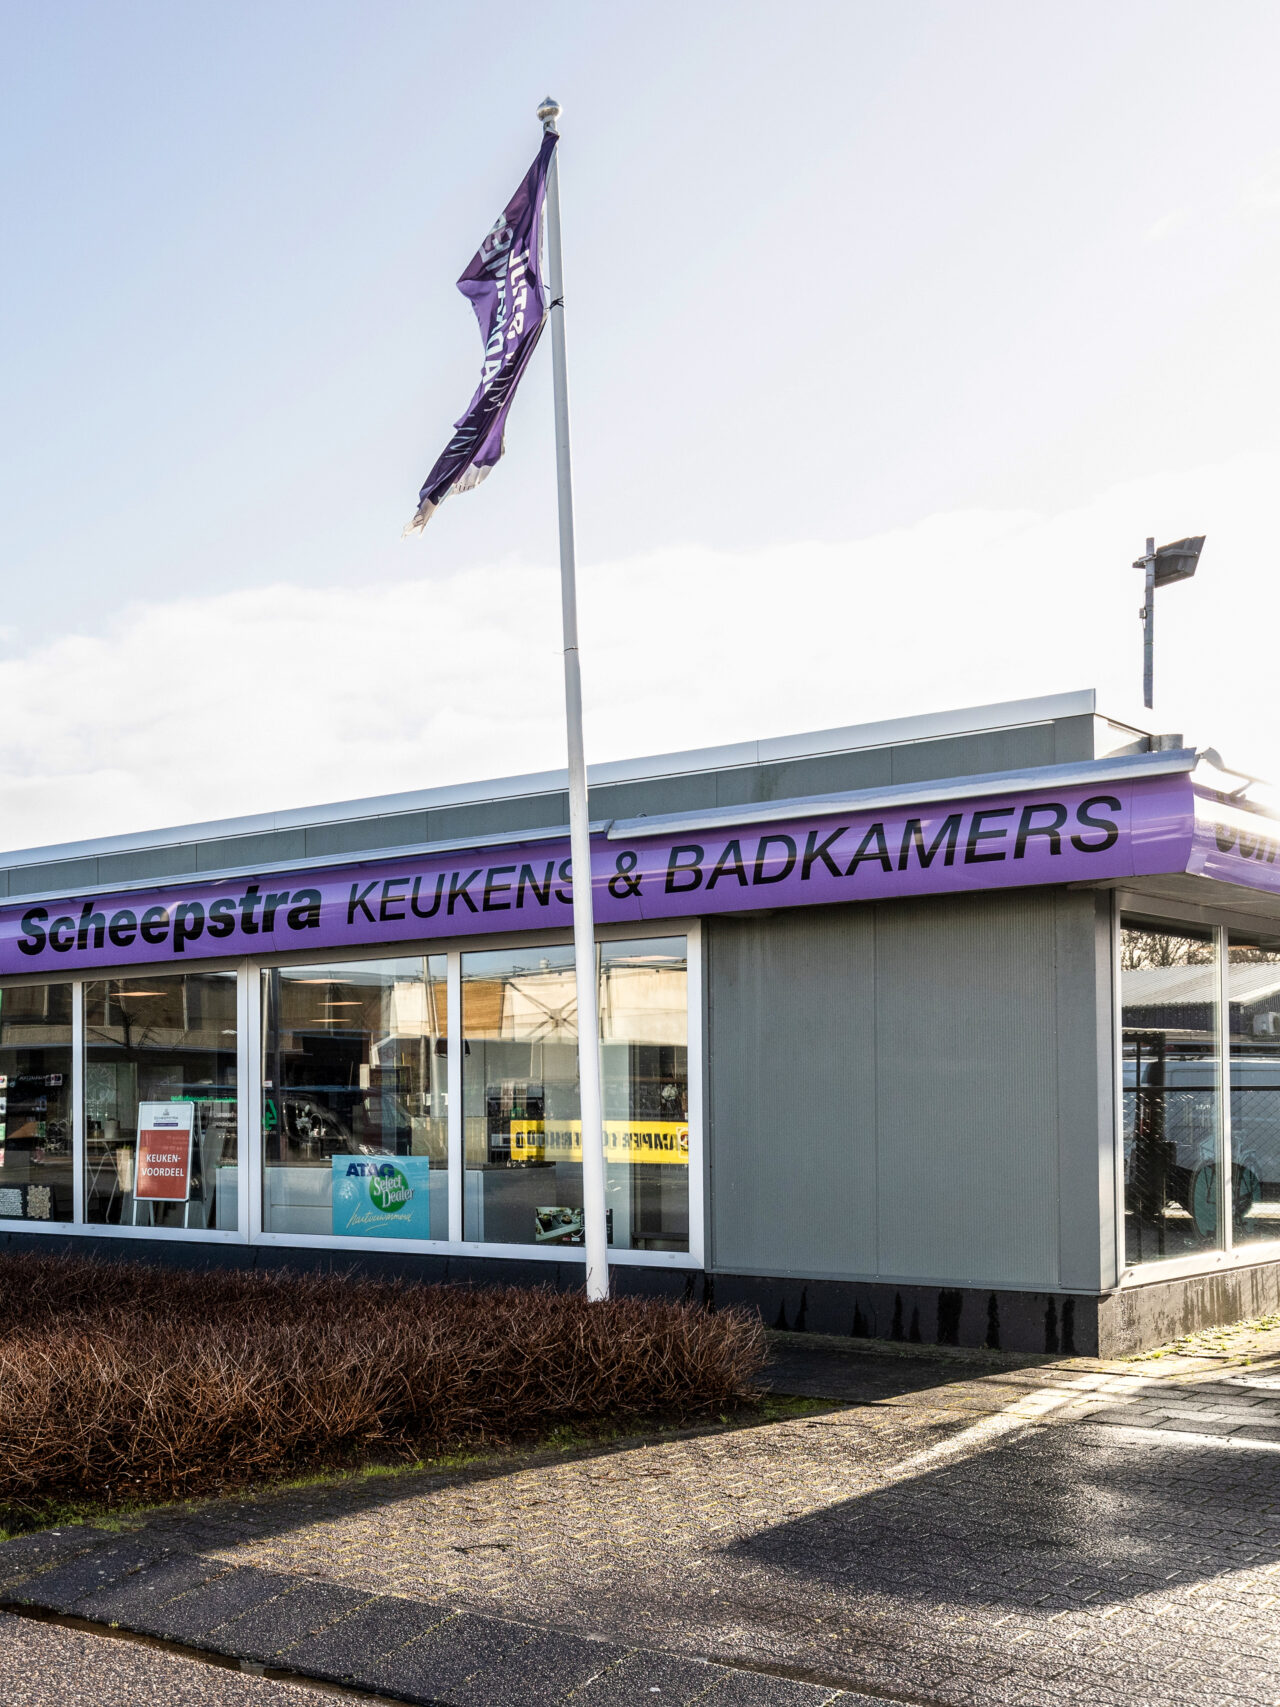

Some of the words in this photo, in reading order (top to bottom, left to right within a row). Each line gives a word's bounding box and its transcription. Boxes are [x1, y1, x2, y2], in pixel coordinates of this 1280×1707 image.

[17, 885, 322, 955] Scheepstra
[346, 857, 575, 925] KEUKENS
[607, 850, 643, 898] &
[664, 795, 1123, 894] BADKAMERS
[146, 1153, 181, 1163] KEUKEN-
[141, 1167, 184, 1177] VOORDEEL
[345, 1162, 395, 1178] ATAG
[373, 1174, 402, 1196] Select
[382, 1186, 415, 1208] Dealer
